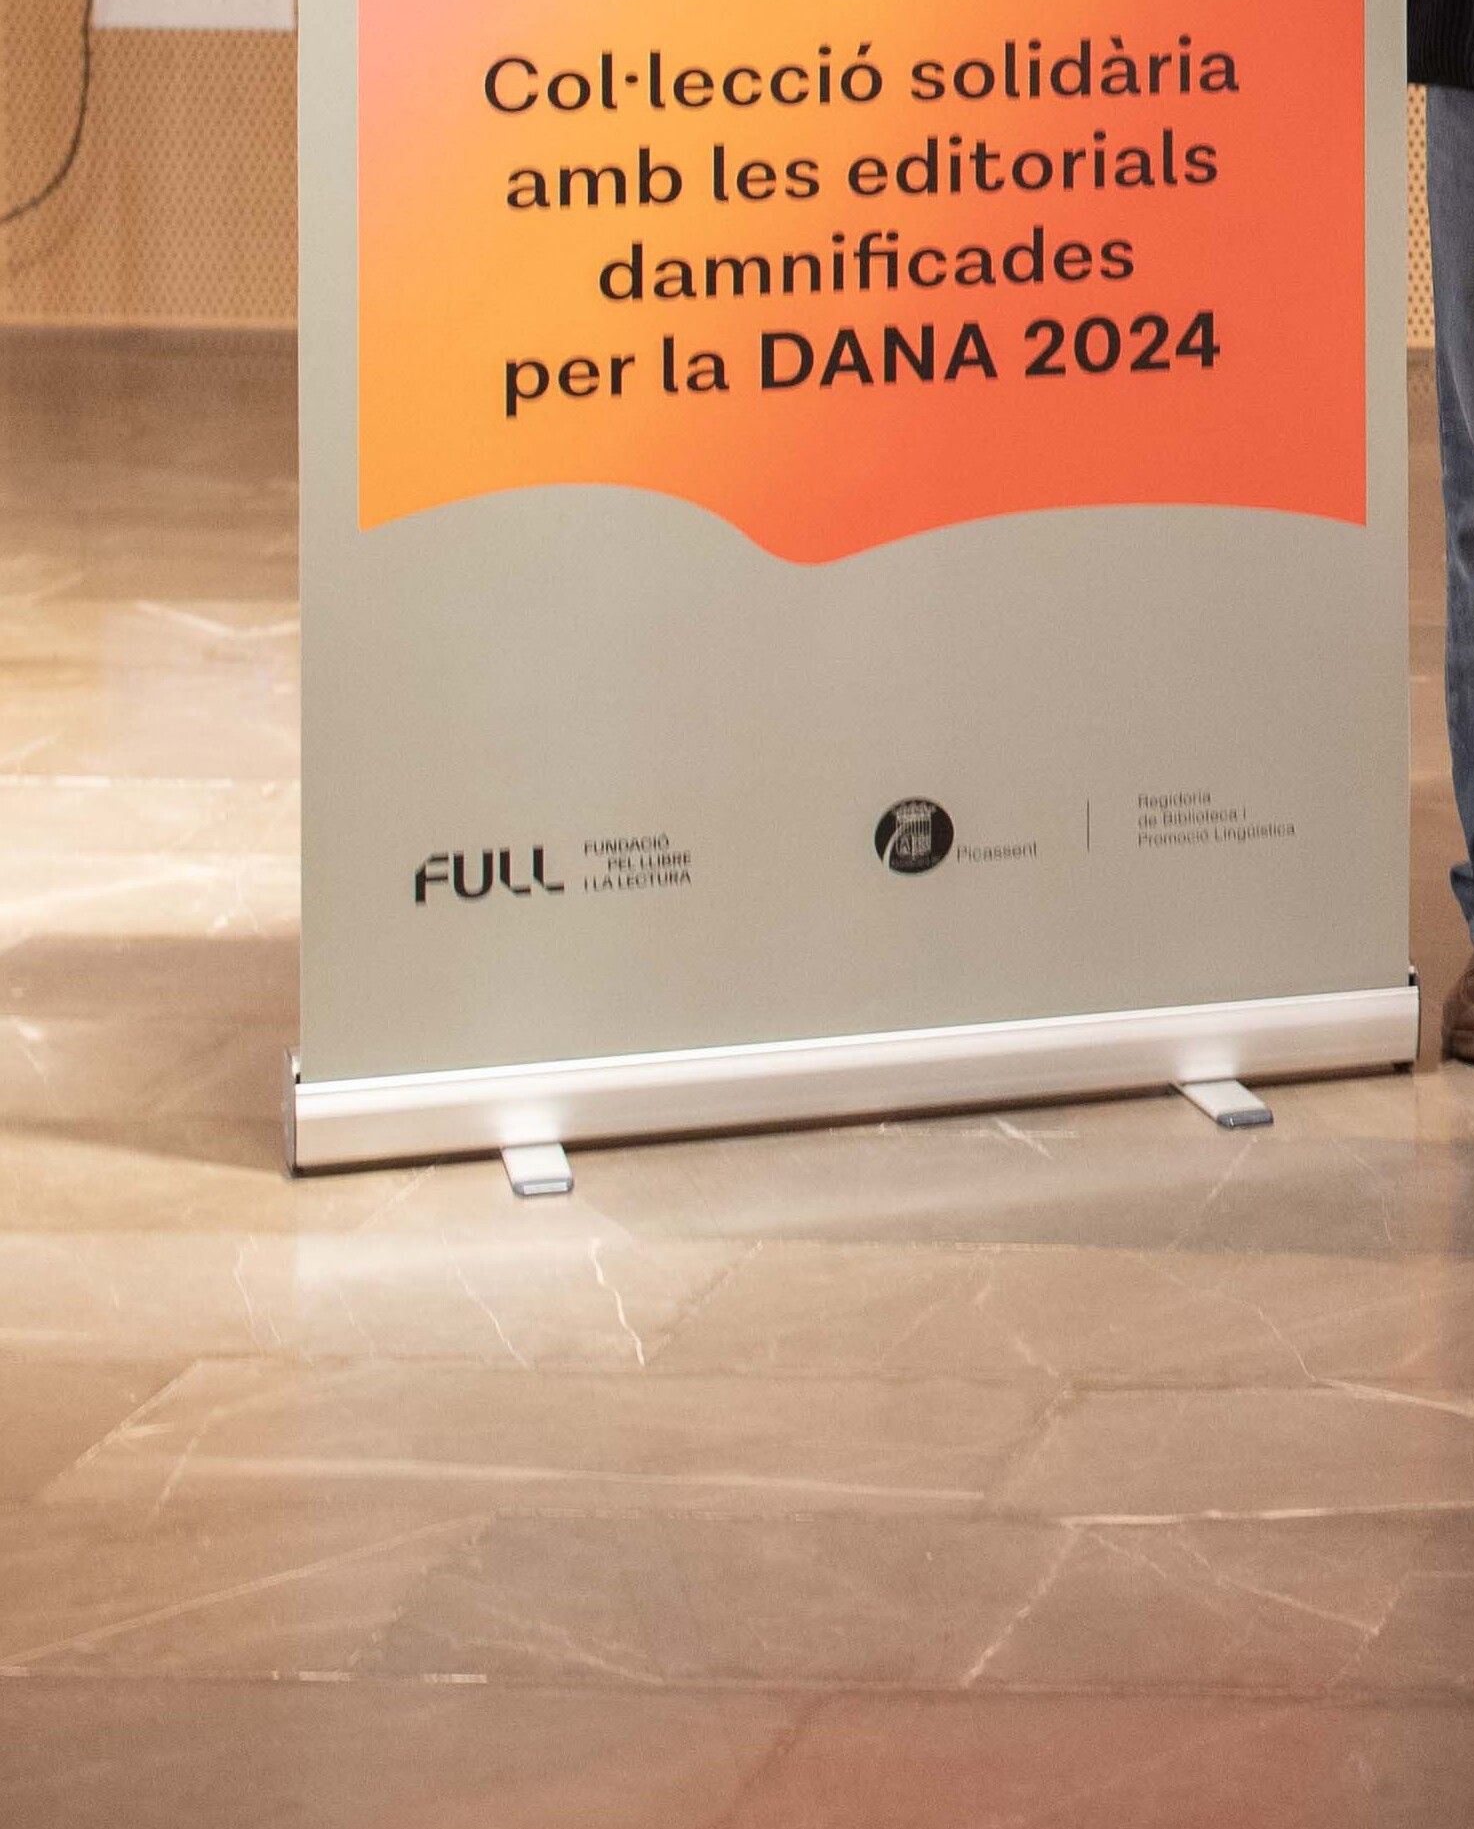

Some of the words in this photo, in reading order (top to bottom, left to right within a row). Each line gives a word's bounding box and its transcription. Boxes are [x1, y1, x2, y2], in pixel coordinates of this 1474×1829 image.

[484, 42, 885, 115] Col·lecció
[910, 34, 1240, 105] solidària
[506, 145, 684, 212] amb
[711, 142, 822, 204] les
[848, 127, 1220, 198] editorials
[599, 226, 1138, 304] damnificades
[505, 344, 635, 419] per
[661, 336, 730, 394] la
[759, 322, 998, 391] DANA
[1023, 311, 1221, 379] 2024
[1137, 813, 1157, 829] de
[1161, 808, 1238, 827] Biblioteca
[583, 832, 671, 856] FUNDACIÓ
[607, 853, 636, 872] PEL
[640, 849, 693, 869] LLIBRE
[956, 840, 1038, 865] Picassent
[415, 844, 565, 904] FULL
[618, 868, 693, 891] LECTURA
